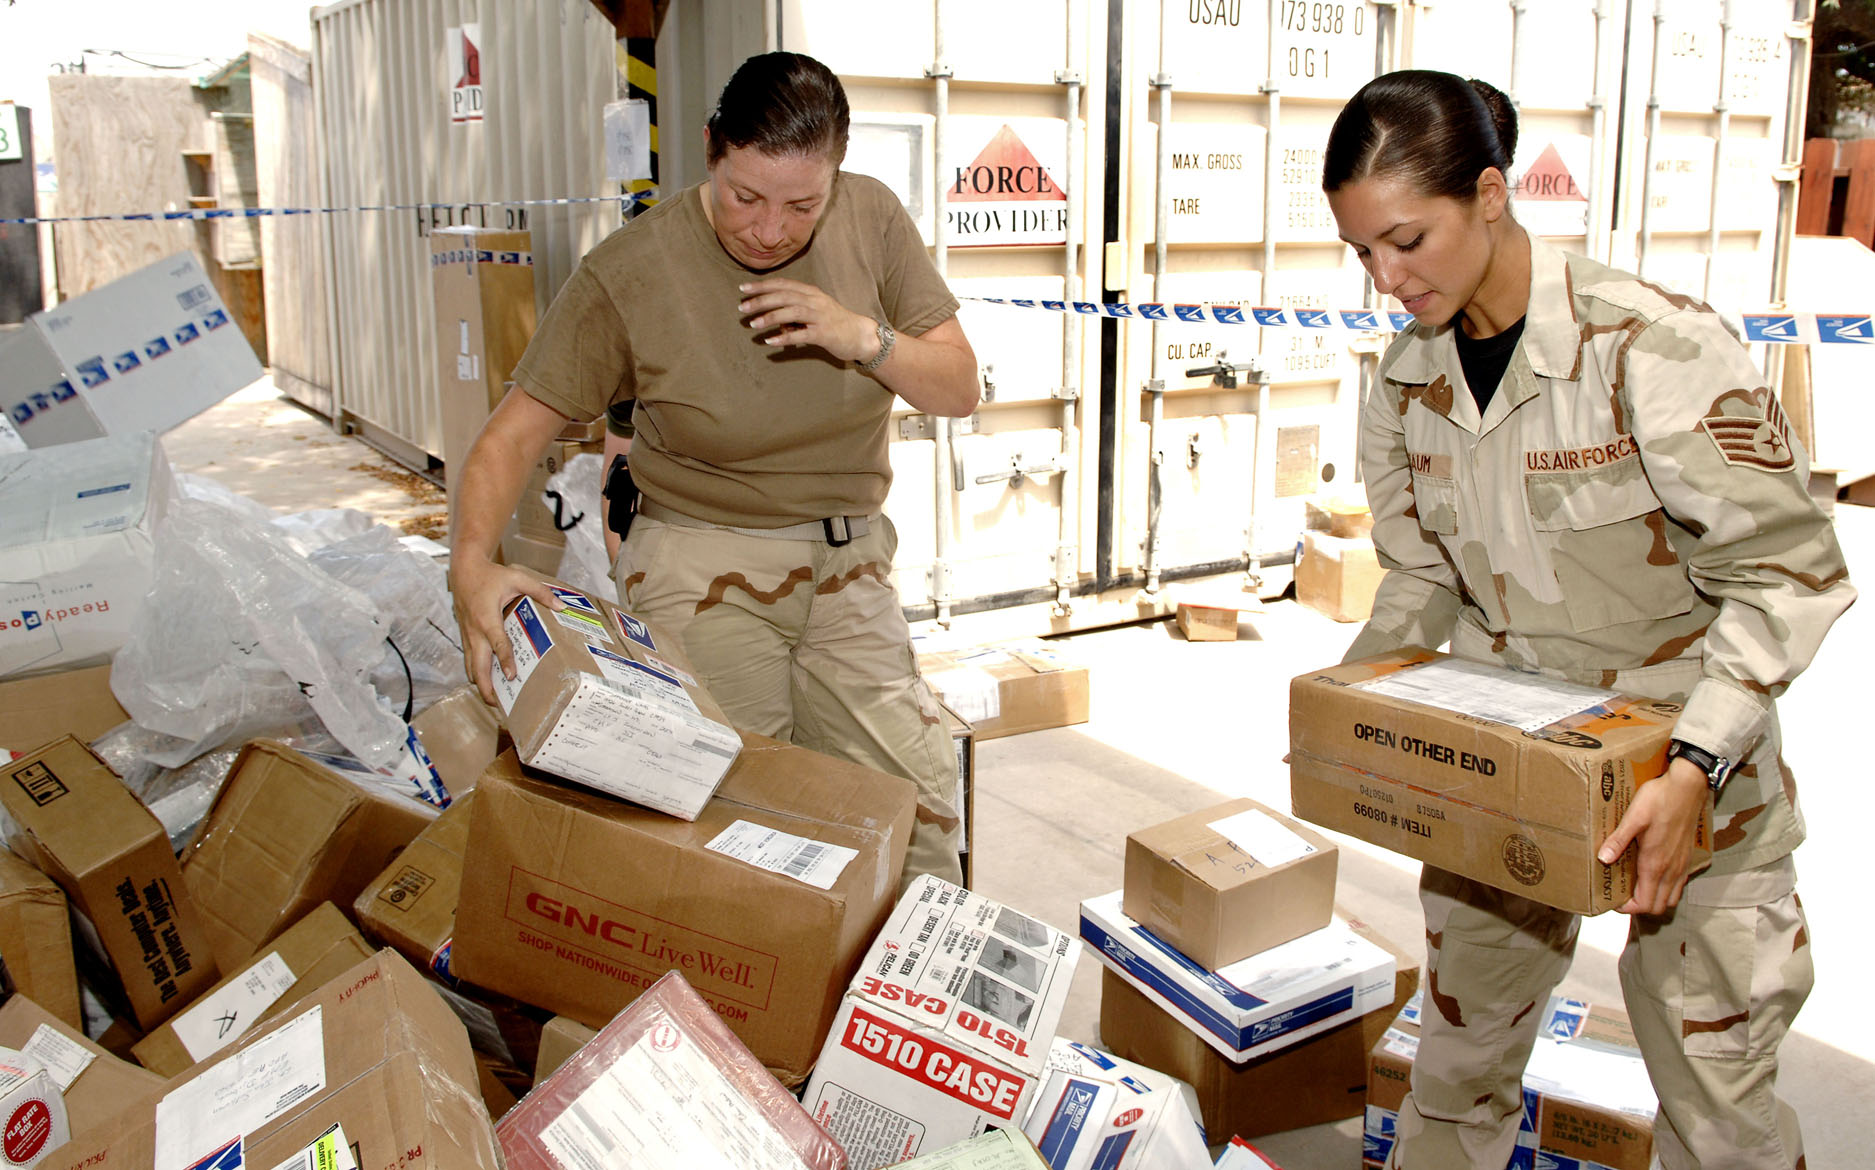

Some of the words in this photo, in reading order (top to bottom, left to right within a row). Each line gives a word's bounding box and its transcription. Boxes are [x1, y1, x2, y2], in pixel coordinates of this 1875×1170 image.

[1312, 4, 1344, 34] 938
[1207, 154, 1242, 170] GROSS
[1283, 147, 1317, 164] 24000
[955, 166, 1053, 194] FORCE
[1172, 198, 1200, 215] TARE
[1168, 344, 1185, 360] CU.
[1189, 342, 1213, 359] CAP.
[1552, 450, 1579, 471] AIR
[1353, 722, 1396, 749] OPEN
[1400, 733, 1456, 767] OTHER
[1460, 751, 1497, 777] END
[1353, 802, 1388, 824] 08099
[1390, 814, 1398, 828] #
[1400, 817, 1432, 839] ITEM
[918, 885, 935, 904] SPECIAL
[936, 890, 951, 906] BLACK
[953, 889, 968, 906] COLOR
[526, 892, 636, 949] GNC
[921, 915, 938, 933] DESERT
[128, 910, 160, 962] Computer
[916, 931, 930, 943] TAN
[1055, 934, 1070, 956] OPTIONS
[518, 931, 553, 953] SHOP
[555, 943, 642, 986] NATIONWIDE
[879, 953, 897, 979] PELICAN
[898, 957, 916, 976] GREEN
[146, 956, 170, 985] Best
[157, 979, 179, 1003] The
[862, 976, 948, 1016] CASE
[957, 1010, 1030, 1058] 1510
[852, 1017, 925, 1070] 1510
[925, 1052, 1020, 1113] CASE
[1374, 1066, 1406, 1082] 46252
[814, 1099, 829, 1123] Lifetime
[1063, 1101, 1076, 1116] MAIL
[1070, 1105, 1086, 1130] PRIORITY
[5, 1120, 24, 1140] FLAT
[20, 1103, 40, 1124] RATE
[17, 1119, 34, 1137] BOX
